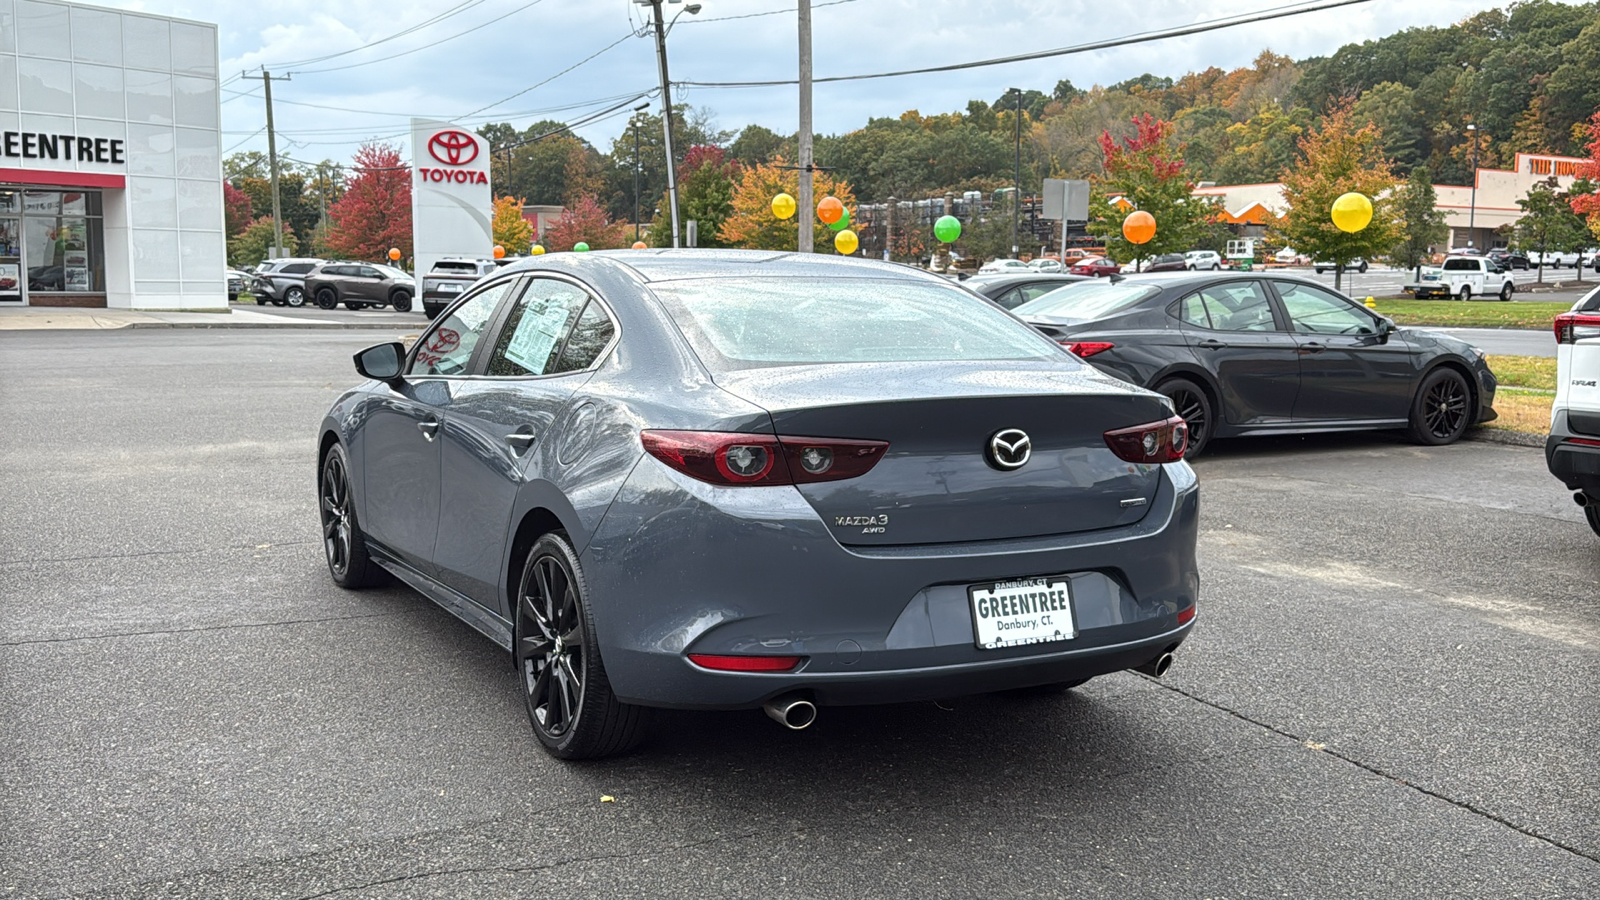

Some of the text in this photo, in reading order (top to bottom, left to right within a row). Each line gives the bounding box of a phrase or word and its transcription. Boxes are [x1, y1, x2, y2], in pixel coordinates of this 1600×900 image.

[0, 131, 125, 163] EENTREE
[1530, 158, 1577, 176] THE HOM
[419, 168, 488, 184] TOYOTA
[835, 514, 888, 526] MAZDA3
[995, 578, 1048, 590] DANBURY, CT
[978, 590, 1066, 619] GREENTREE
[997, 615, 1054, 631] Danbury, CT.
[985, 633, 1075, 650] GREENTREE
